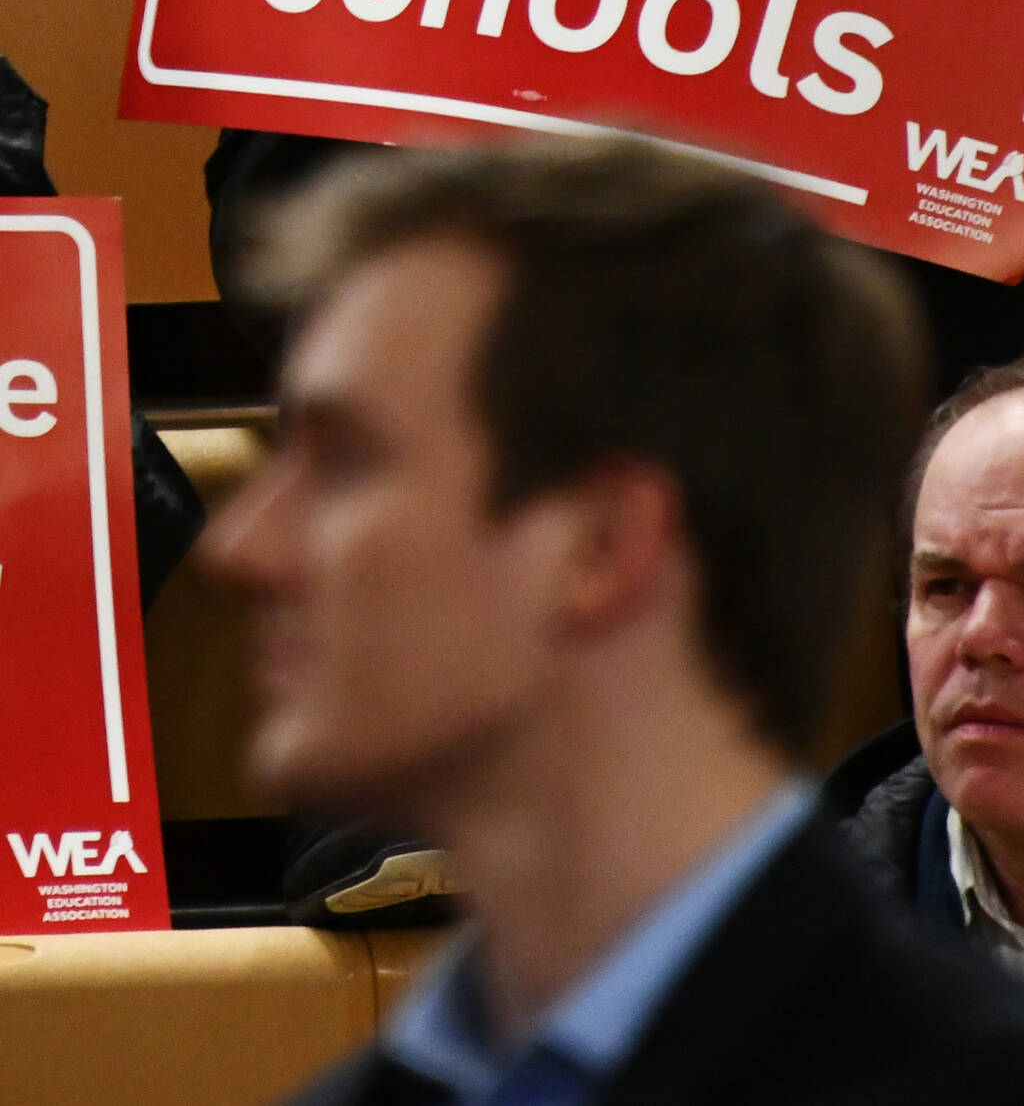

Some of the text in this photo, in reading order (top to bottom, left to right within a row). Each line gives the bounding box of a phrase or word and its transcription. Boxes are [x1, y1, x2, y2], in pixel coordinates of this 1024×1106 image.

[916, 182, 1003, 216] WASHINGTON
[918, 198, 993, 229] EDUCATION
[908, 211, 994, 244] ASSOCIATION
[6, 830, 149, 878] WEA
[38, 882, 128, 896] WASHINGTON
[46, 896, 123, 909] EDUCATION
[42, 909, 131, 922] ASSOCIATION
